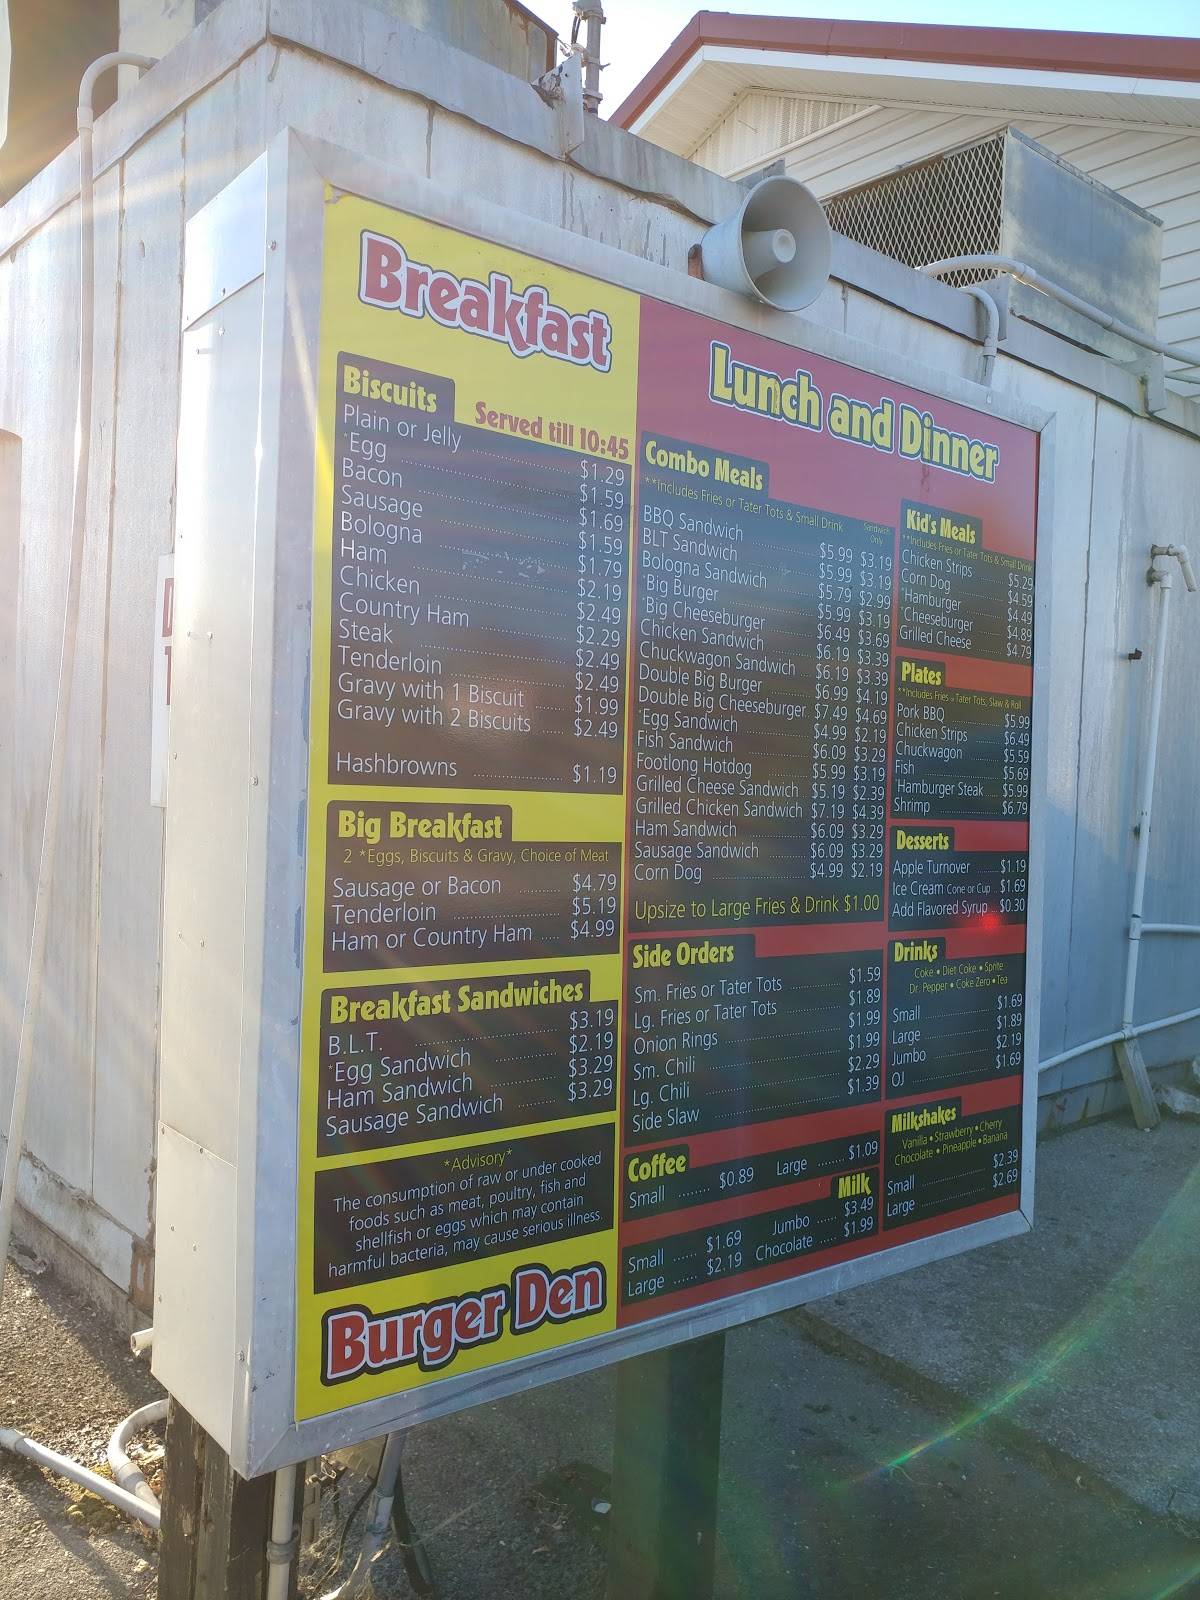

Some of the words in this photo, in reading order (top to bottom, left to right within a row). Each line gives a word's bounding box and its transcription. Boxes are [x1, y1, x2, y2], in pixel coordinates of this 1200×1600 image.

[361, 231, 611, 371] Breakfast
[343, 364, 436, 412] Biscuits
[474, 400, 542, 439] Served
[548, 421, 574, 446] till
[579, 427, 628, 460] 10:45
[710, 341, 821, 431] Lunch
[829, 394, 893, 453] and
[899, 403, 998, 483] Dinner
[344, 403, 389, 432] Plain
[397, 421, 417, 437] or
[423, 422, 461, 453] Jelly
[580, 459, 624, 486] $1.29
[645, 440, 709, 477] Combo
[714, 457, 762, 490] Meals
[341, 484, 422, 520] Sausage
[578, 529, 622, 555] $1.59
[643, 504, 673, 529] BBQ
[678, 512, 742, 542] Sandwich
[819, 541, 852, 563] $5.99
[860, 551, 891, 571] $3.19
[906, 508, 936, 534] Kid's
[939, 517, 975, 544] Meals
[341, 537, 386, 564] Ham
[577, 577, 621, 601] $2.19
[901, 548, 942, 570] Chicken
[945, 558, 972, 579] Strips
[1008, 572, 1033, 590] $5.29
[339, 591, 420, 625] Country
[427, 603, 468, 626] Ham
[576, 623, 620, 647] $2.29
[640, 617, 696, 641] Chicken
[701, 626, 763, 651] Sandwich
[816, 642, 849, 662] $6.19
[857, 648, 888, 667] $3.39
[899, 624, 932, 643] Grilled
[935, 630, 971, 649] Cheese
[1006, 641, 1031, 659] $4.79
[337, 644, 441, 674] Tenderloin
[575, 670, 618, 693] $2.49
[639, 662, 689, 684] Double
[694, 669, 714, 692] Big
[719, 669, 762, 696] Burger
[814, 682, 848, 701] $6.99
[855, 686, 887, 705] $4.19
[901, 661, 941, 685] Plates
[338, 671, 395, 701] Gravy
[402, 679, 443, 700] with
[452, 682, 458, 701] 1
[469, 684, 523, 707] Biscuit
[574, 693, 618, 715] $1.99
[896, 702, 919, 719] Pork
[923, 705, 944, 723] BBQ
[1004, 712, 1030, 729] $5.99
[336, 751, 456, 776] Hashbrowns
[572, 763, 616, 783] $1.19
[637, 729, 663, 747] Fish
[668, 732, 732, 752] Sandwich
[812, 742, 846, 760] $6.09
[853, 744, 885, 762] $3.29
[338, 809, 381, 844] Big
[389, 810, 502, 842] Breakfast
[893, 796, 930, 816] Shrimp
[1001, 800, 1027, 815] $6.79
[635, 819, 667, 836] Ham
[672, 819, 736, 837] Sandwich
[810, 821, 843, 839] $6.09
[851, 822, 883, 840] $3.29
[896, 829, 949, 850] Desserts
[343, 848, 351, 863] 2
[410, 848, 458, 862] Biscuits
[463, 848, 472, 862] &
[477, 848, 515, 865] Gravy,
[520, 847, 561, 861] Choice
[564, 847, 576, 861] of
[580, 848, 608, 861] Meat
[634, 863, 668, 880] Corn
[674, 863, 701, 884] Dog
[809, 861, 843, 879] $4.99
[850, 861, 882, 879] $2.19
[892, 859, 923, 878] Apple
[926, 859, 970, 874] Turnover
[1000, 858, 1026, 874] $1.19
[332, 877, 415, 901] Sausage
[421, 880, 441, 895] or
[447, 875, 500, 894] Bacon
[572, 872, 616, 893] $4.79
[635, 899, 685, 923] Upsize
[690, 900, 706, 917] to
[711, 898, 750, 920] Large
[755, 896, 785, 914] Fries
[790, 896, 800, 913] &
[805, 893, 839, 912] Drink
[843, 893, 879, 912] $1.00
[332, 930, 377, 951] Ham
[386, 932, 406, 948] or
[413, 926, 487, 948] Country
[493, 923, 531, 942] Ham
[570, 919, 614, 940] $4.99
[632, 943, 671, 968] Side
[676, 940, 734, 965] Orders
[894, 940, 937, 962] Drinks
[330, 989, 451, 1023] Breakfast
[457, 978, 583, 1012] Sandwiches
[633, 1034, 676, 1054] Onion
[682, 1031, 717, 1050] Rings
[848, 1009, 880, 1029] $1.99
[892, 1029, 920, 1046] Large
[996, 1012, 1022, 1029] $1.89
[327, 1088, 373, 1109] Ham
[381, 1071, 471, 1102] Sandwich
[568, 1054, 612, 1079] $3.29
[632, 1111, 662, 1132] Side
[667, 1107, 699, 1126] Slaw
[847, 1074, 879, 1095] $1.39
[325, 1111, 408, 1136] Sausage
[416, 1092, 502, 1123] Sandwich
[567, 1077, 612, 1102] $3.29
[891, 1105, 956, 1133] Milkshakes
[627, 1152, 686, 1182] Coffee
[629, 1184, 664, 1208] Small
[719, 1166, 753, 1189] $0.89
[776, 1158, 807, 1175] Large
[848, 1140, 878, 1160] $1.09
[887, 1173, 914, 1195] Small
[992, 1148, 1018, 1169] $2.39
[894, 1148, 933, 1165] Chocolate
[348, 1210, 389, 1231] foods
[393, 1203, 424, 1223] such
[429, 1203, 443, 1216] as
[448, 1194, 484, 1212] meat,
[489, 1185, 535, 1208] poultry,
[539, 1177, 560, 1194] fish
[564, 1171, 585, 1189] and
[837, 1172, 871, 1198] Milk
[355, 1226, 411, 1251] shellfish
[416, 1226, 431, 1239] or
[435, 1219, 465, 1237] eggs
[469, 1207, 507, 1228] which
[512, 1204, 537, 1219] may
[540, 1195, 583, 1213] contain
[628, 1247, 663, 1273] Small
[706, 1229, 741, 1253] $1.69
[771, 1213, 809, 1235] Jumbo
[844, 1195, 873, 1217] $3.49
[326, 1289, 506, 1380] Burger
[515, 1267, 603, 1330] Den
